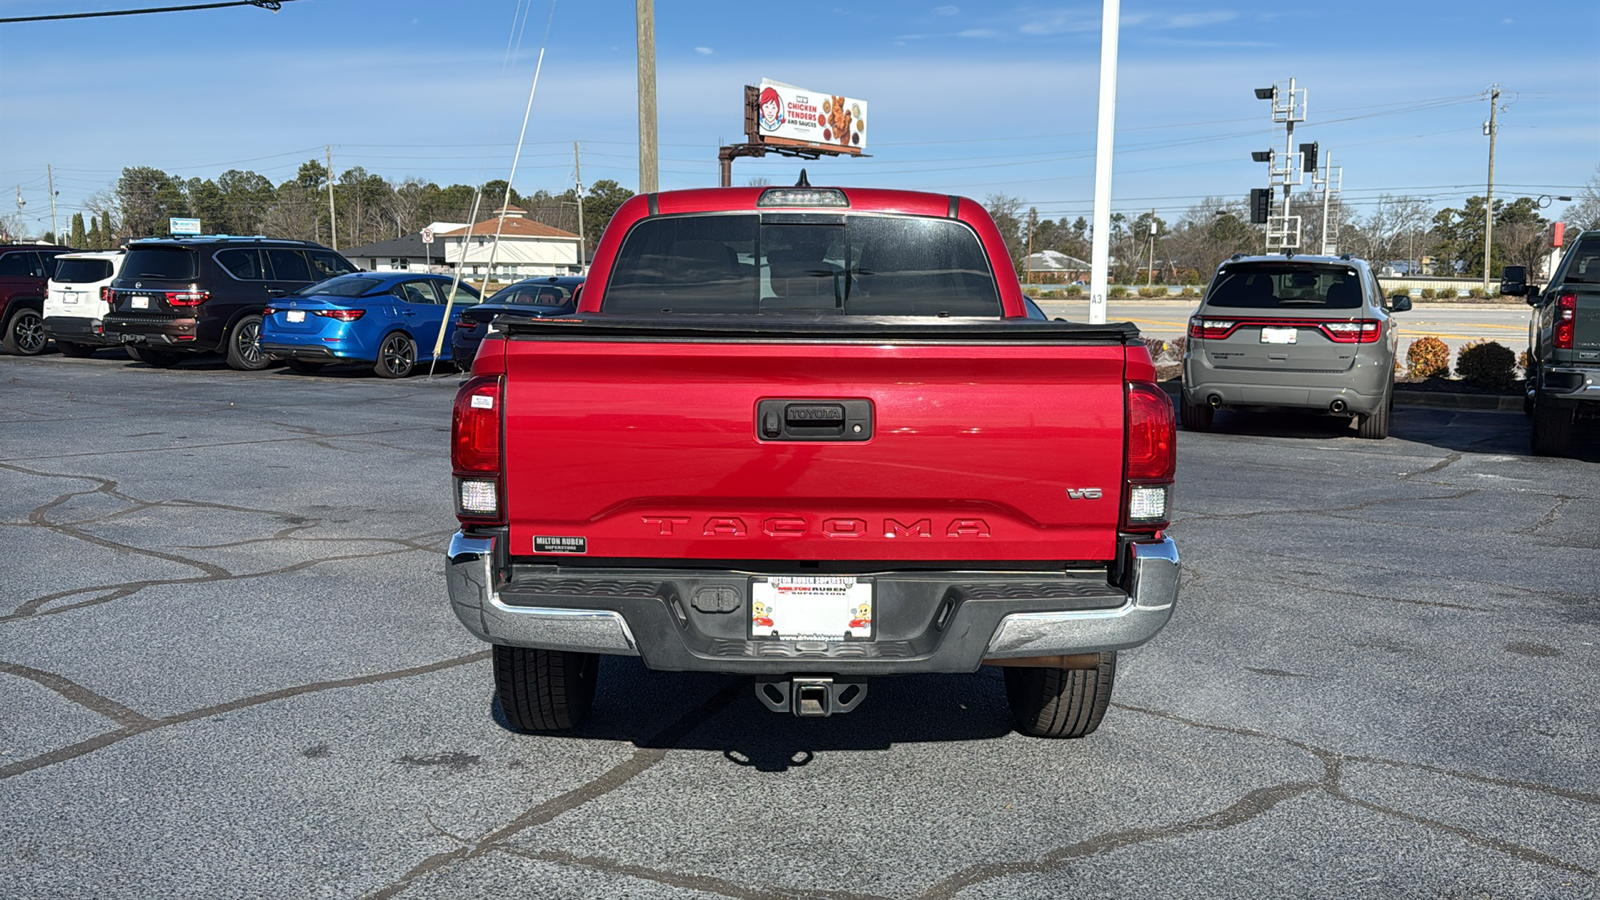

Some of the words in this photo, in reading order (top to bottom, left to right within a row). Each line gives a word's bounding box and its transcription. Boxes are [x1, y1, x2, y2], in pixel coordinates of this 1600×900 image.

[787, 102, 817, 113] CHICKEN
[787, 110, 817, 121] TENDERS
[1091, 294, 1102, 304] A3
[790, 408, 840, 419] TOYOTA
[1066, 488, 1102, 500] V6
[640, 515, 991, 538] TACOMA
[536, 537, 560, 545] MILTON
[562, 538, 584, 546] RUBEN
